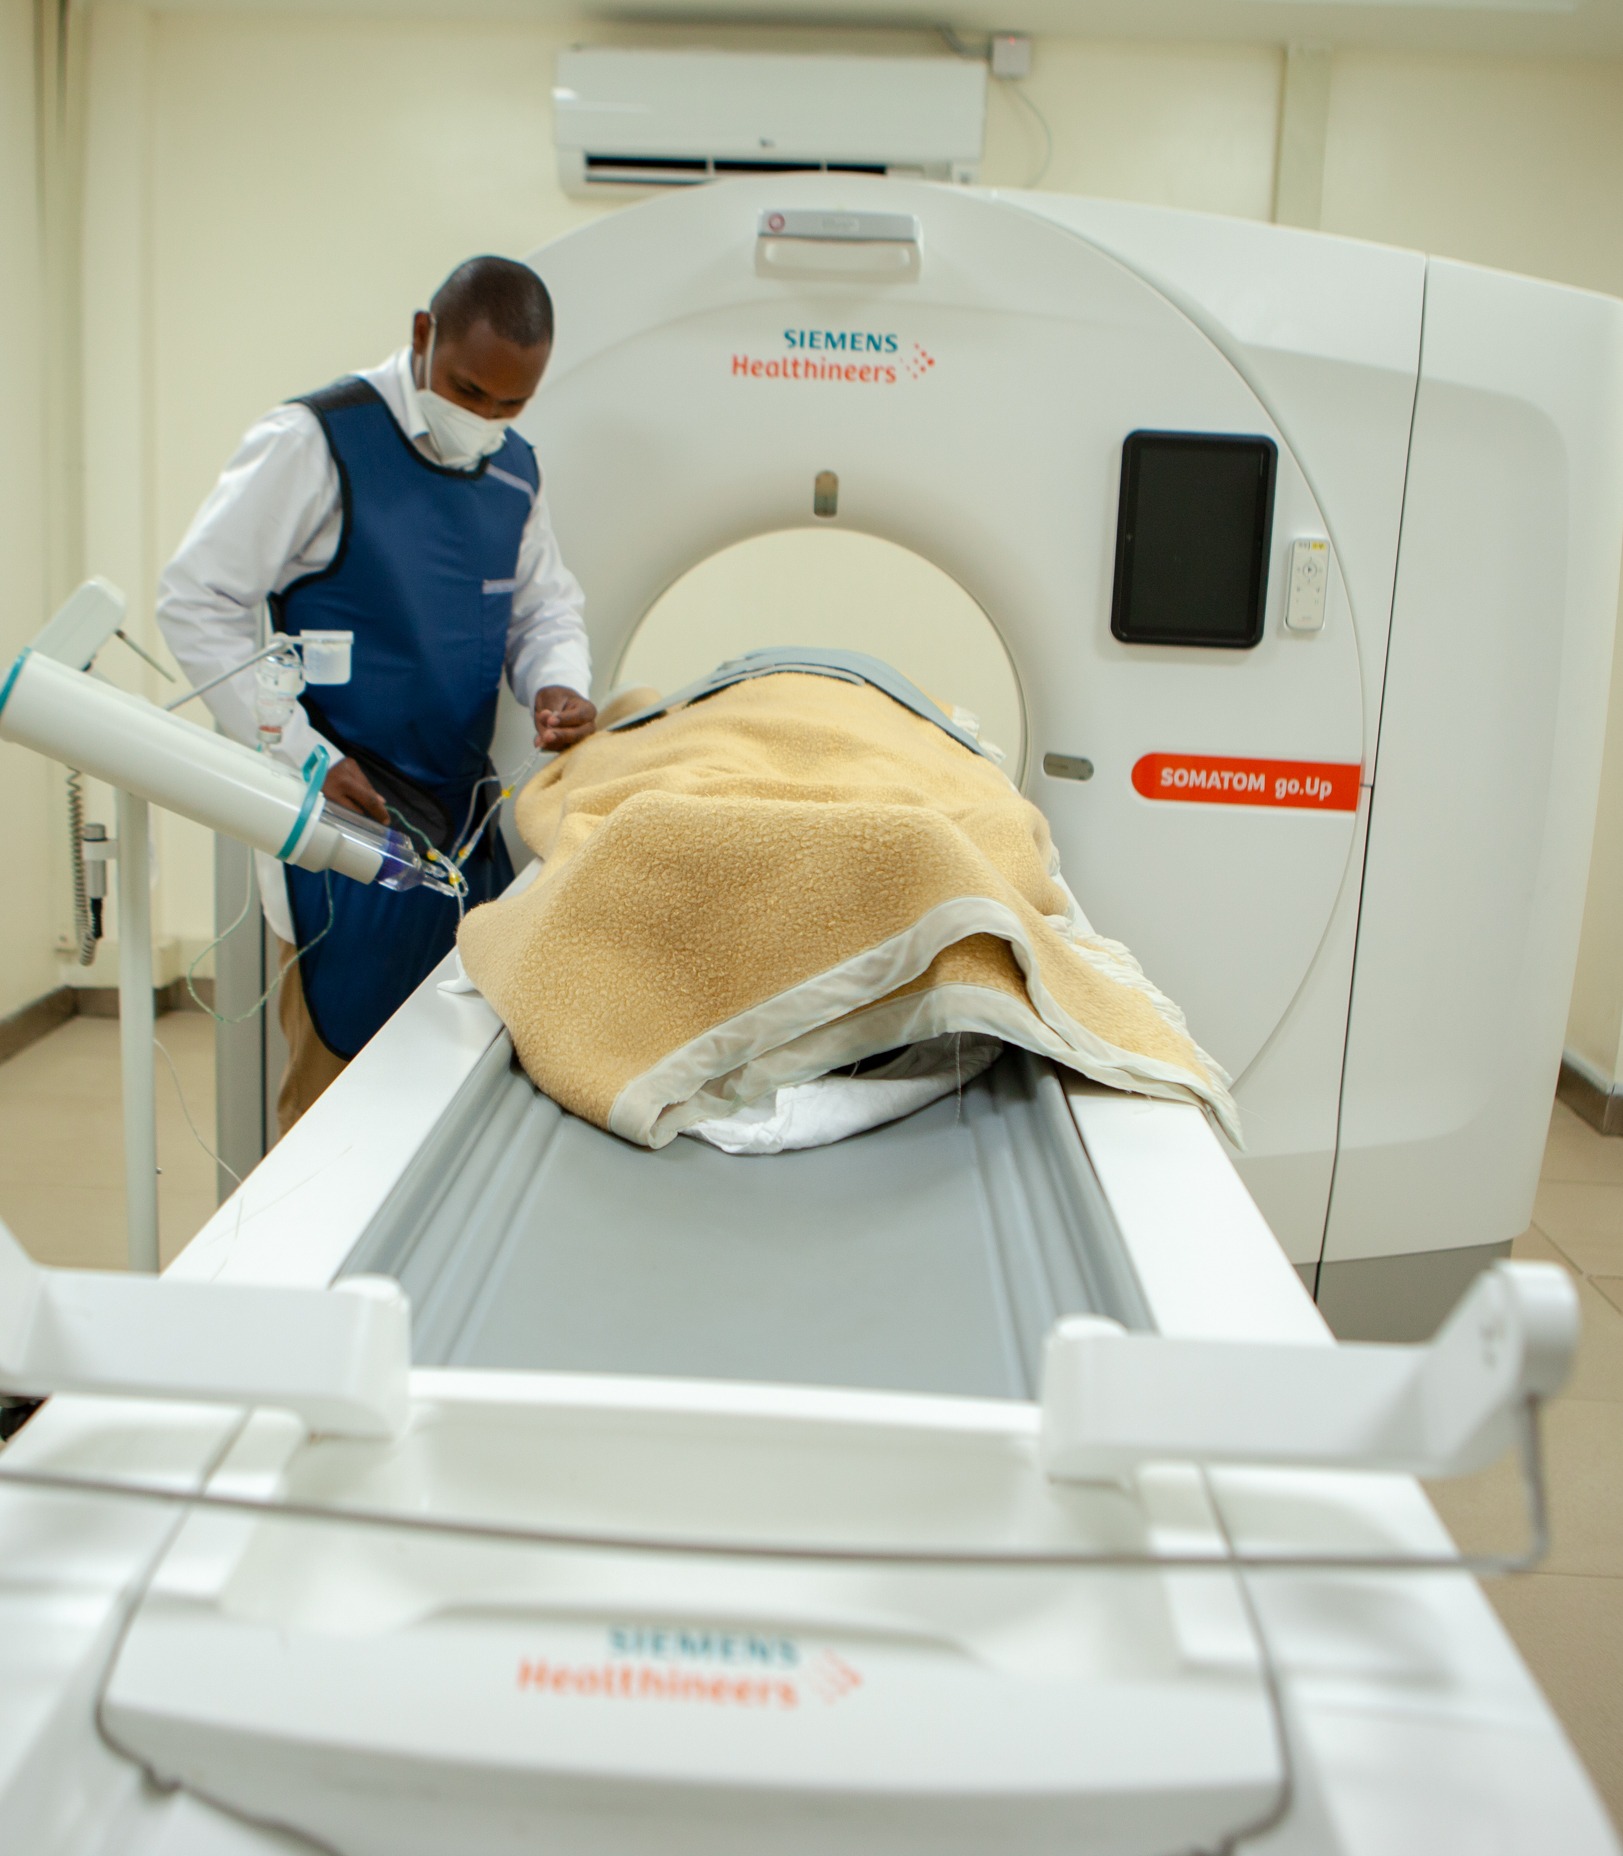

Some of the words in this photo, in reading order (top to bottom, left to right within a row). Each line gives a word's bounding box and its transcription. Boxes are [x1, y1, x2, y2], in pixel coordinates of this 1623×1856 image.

[784, 329, 898, 353] SIEMENS
[731, 354, 897, 384] Healthineers
[1160, 767, 1265, 792] SOMATOM
[1275, 776, 1332, 801] go.Up
[607, 1626, 799, 1667] SIEMENS
[517, 1658, 799, 1709] Healthineers
